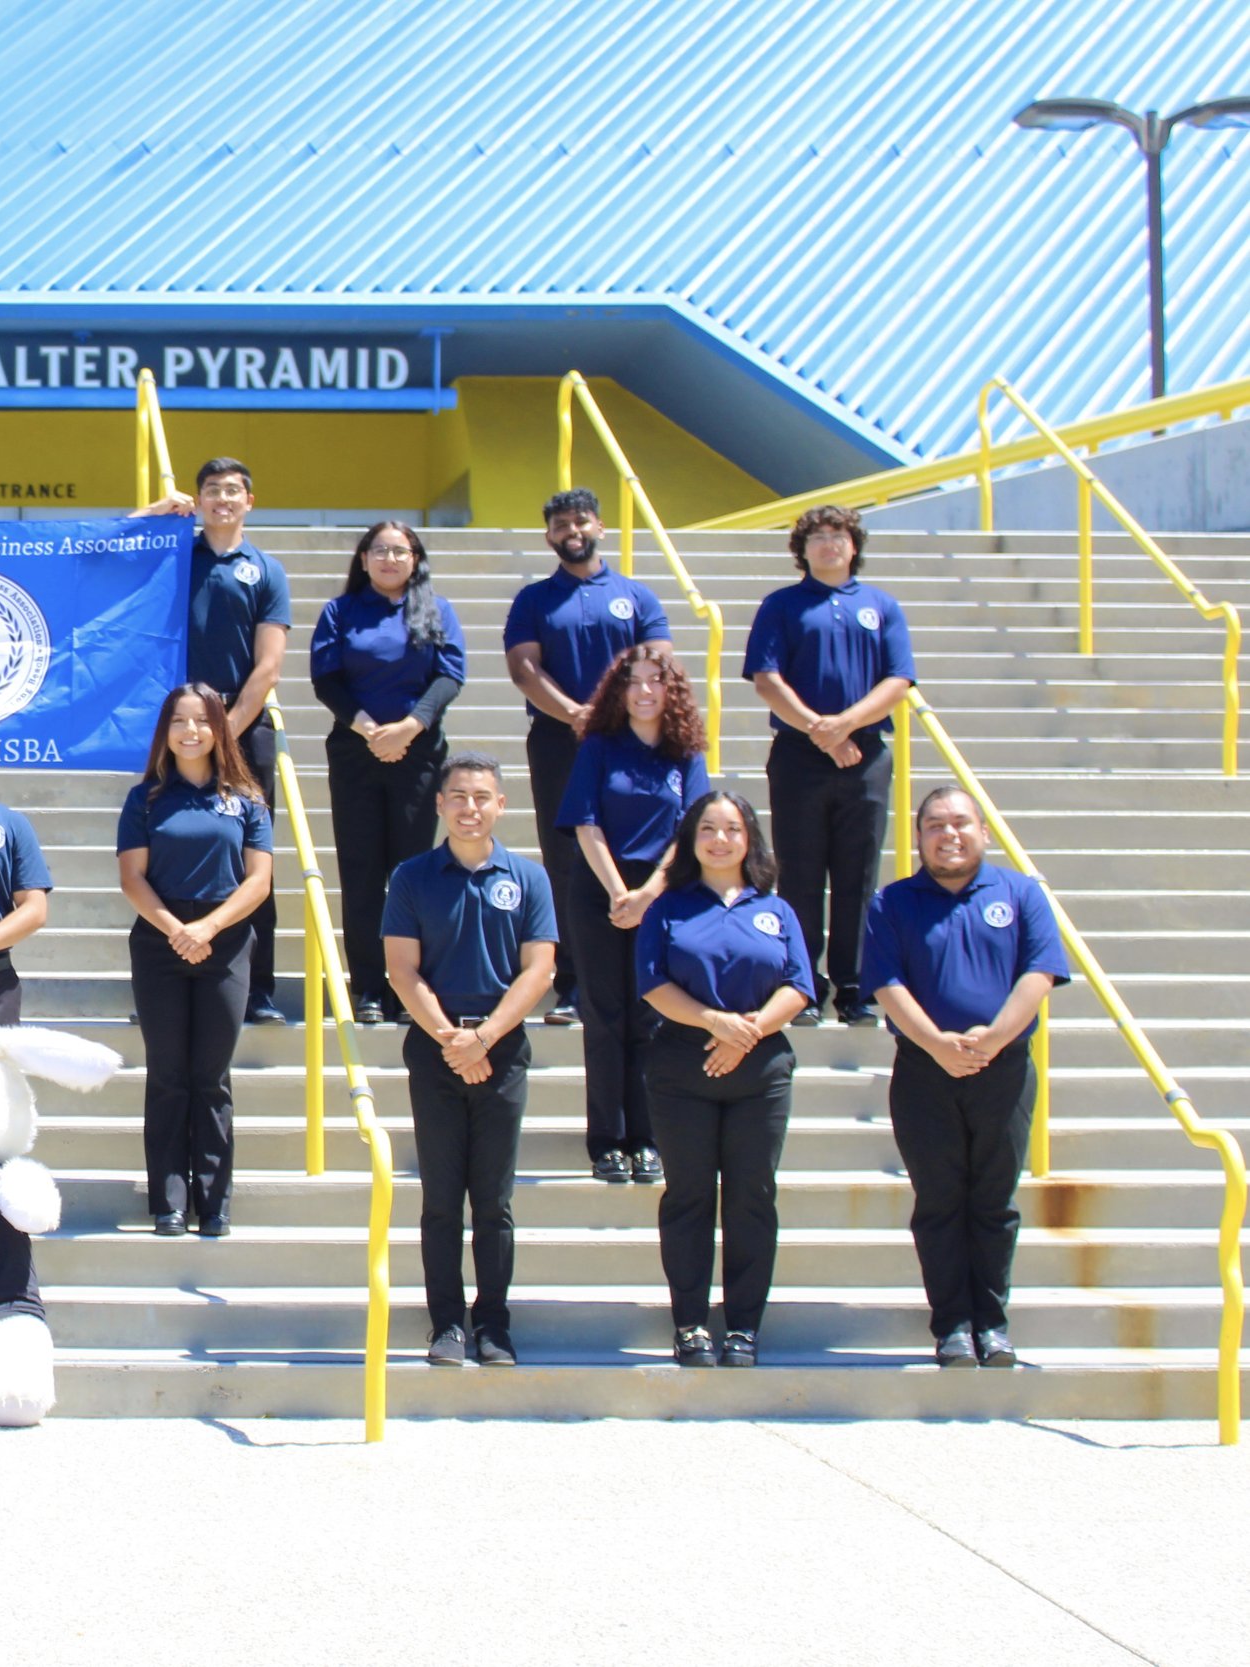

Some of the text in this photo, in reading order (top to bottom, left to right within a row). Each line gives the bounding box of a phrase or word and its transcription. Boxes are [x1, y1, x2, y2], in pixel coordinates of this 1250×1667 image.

[162, 345, 410, 390] PYRAMID
[57, 531, 179, 556] Association
[9, 589, 44, 646] Association
